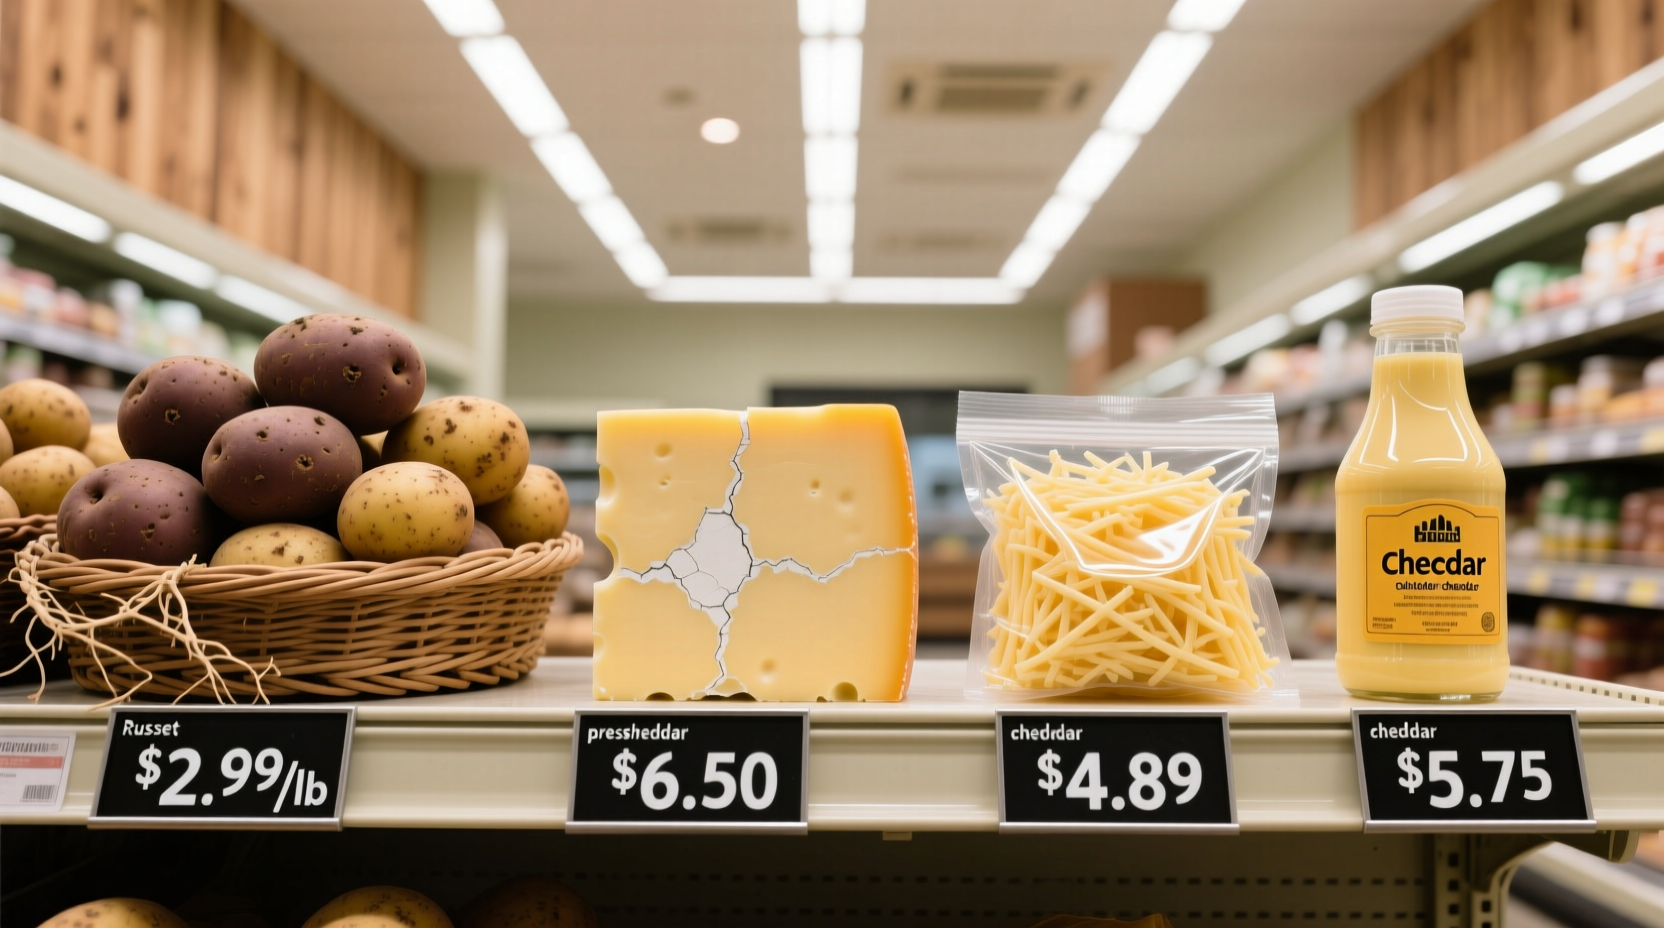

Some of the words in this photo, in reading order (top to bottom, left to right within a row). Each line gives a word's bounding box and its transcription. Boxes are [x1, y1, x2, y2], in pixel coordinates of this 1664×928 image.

[1382, 548, 1487, 576] Checdar
[122, 719, 181, 737] Russet
[587, 722, 689, 744] pressheddar
[1370, 721, 1437, 739] cheddar
[135, 743, 328, 814] $2.99/lb
[611, 747, 778, 811] $6.50
[1037, 748, 1203, 811] $4.89
[1397, 746, 1553, 809] $5.75
